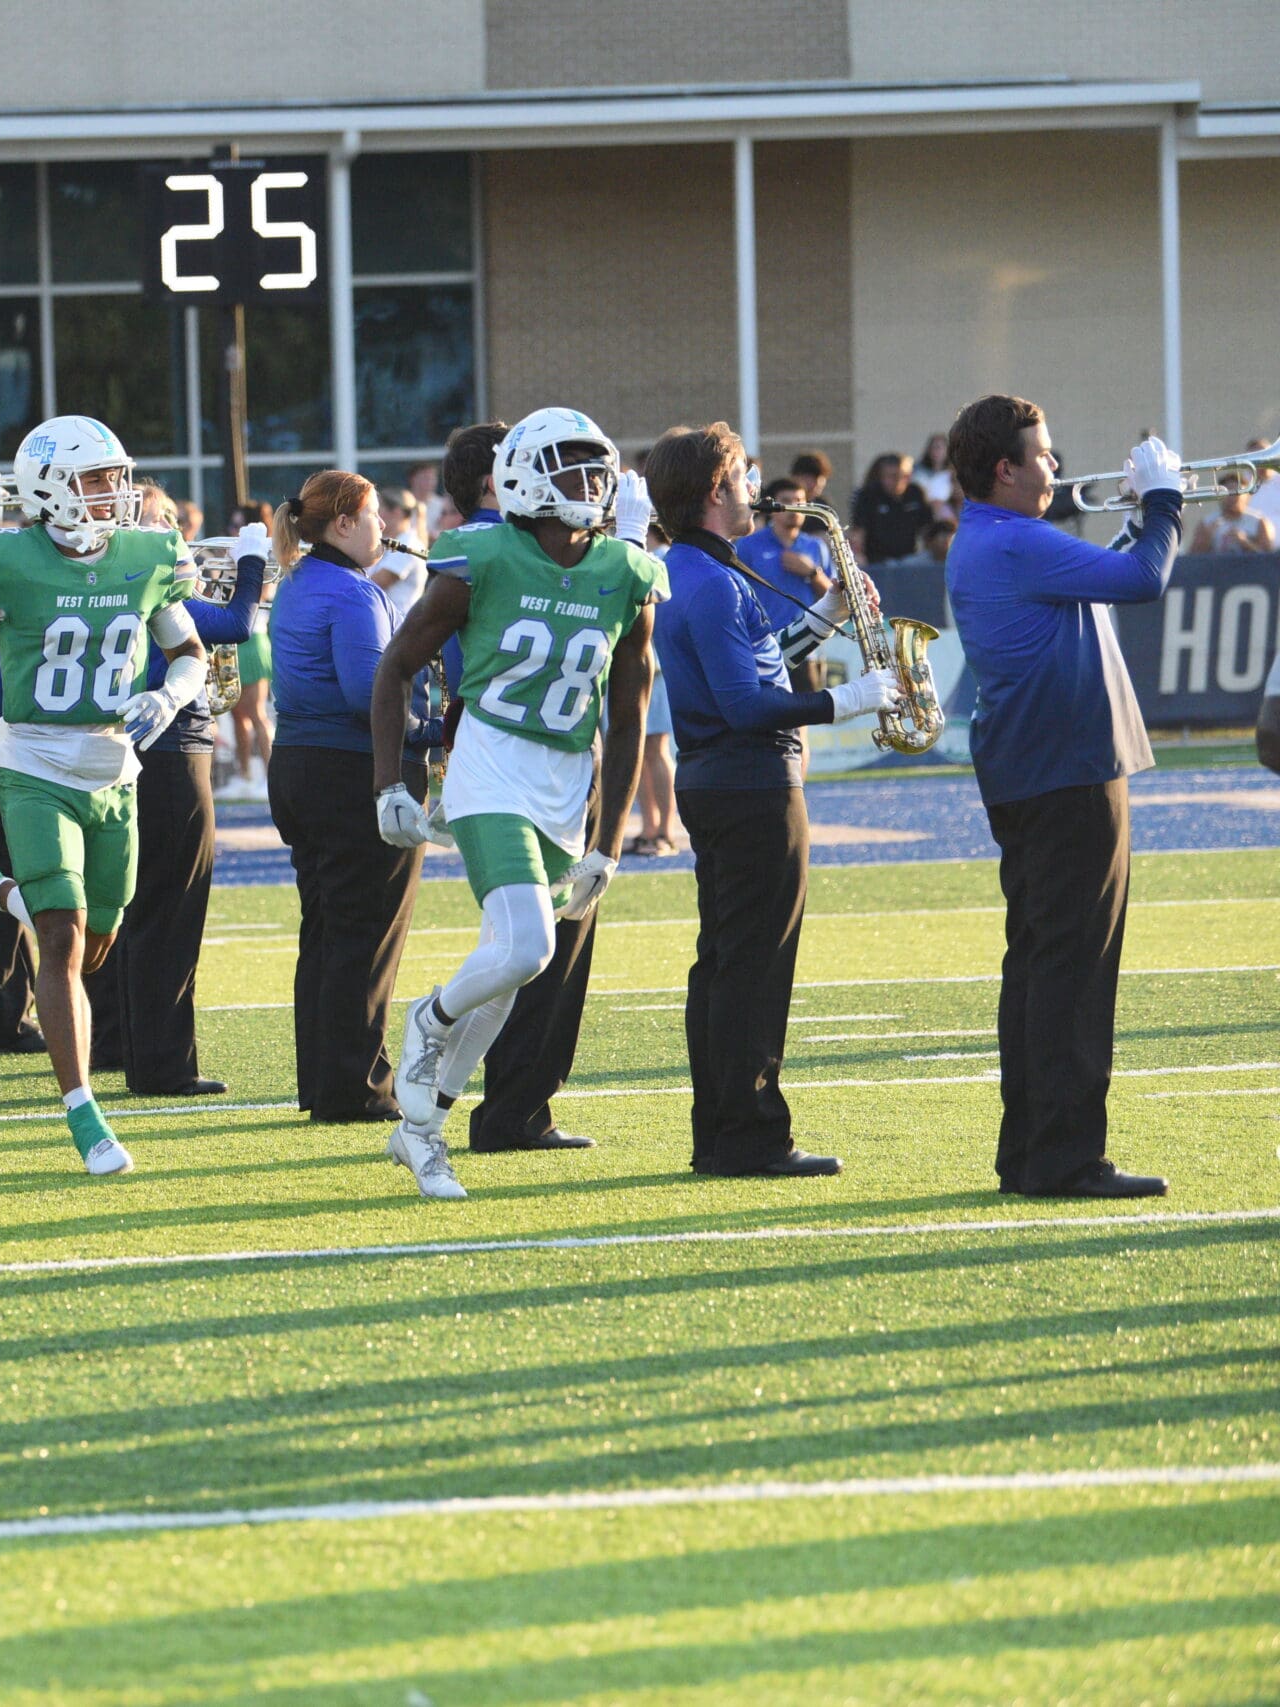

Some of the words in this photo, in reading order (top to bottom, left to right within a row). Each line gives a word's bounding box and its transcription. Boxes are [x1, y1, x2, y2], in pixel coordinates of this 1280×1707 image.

[161, 172, 317, 292] 25
[56, 595, 84, 608] WEST
[88, 593, 128, 608] FLORIDA
[520, 595, 551, 612] WEST
[554, 601, 599, 620] FLORIDA
[1159, 584, 1280, 694] HO
[33, 612, 142, 713] 88
[478, 617, 610, 733] 28
